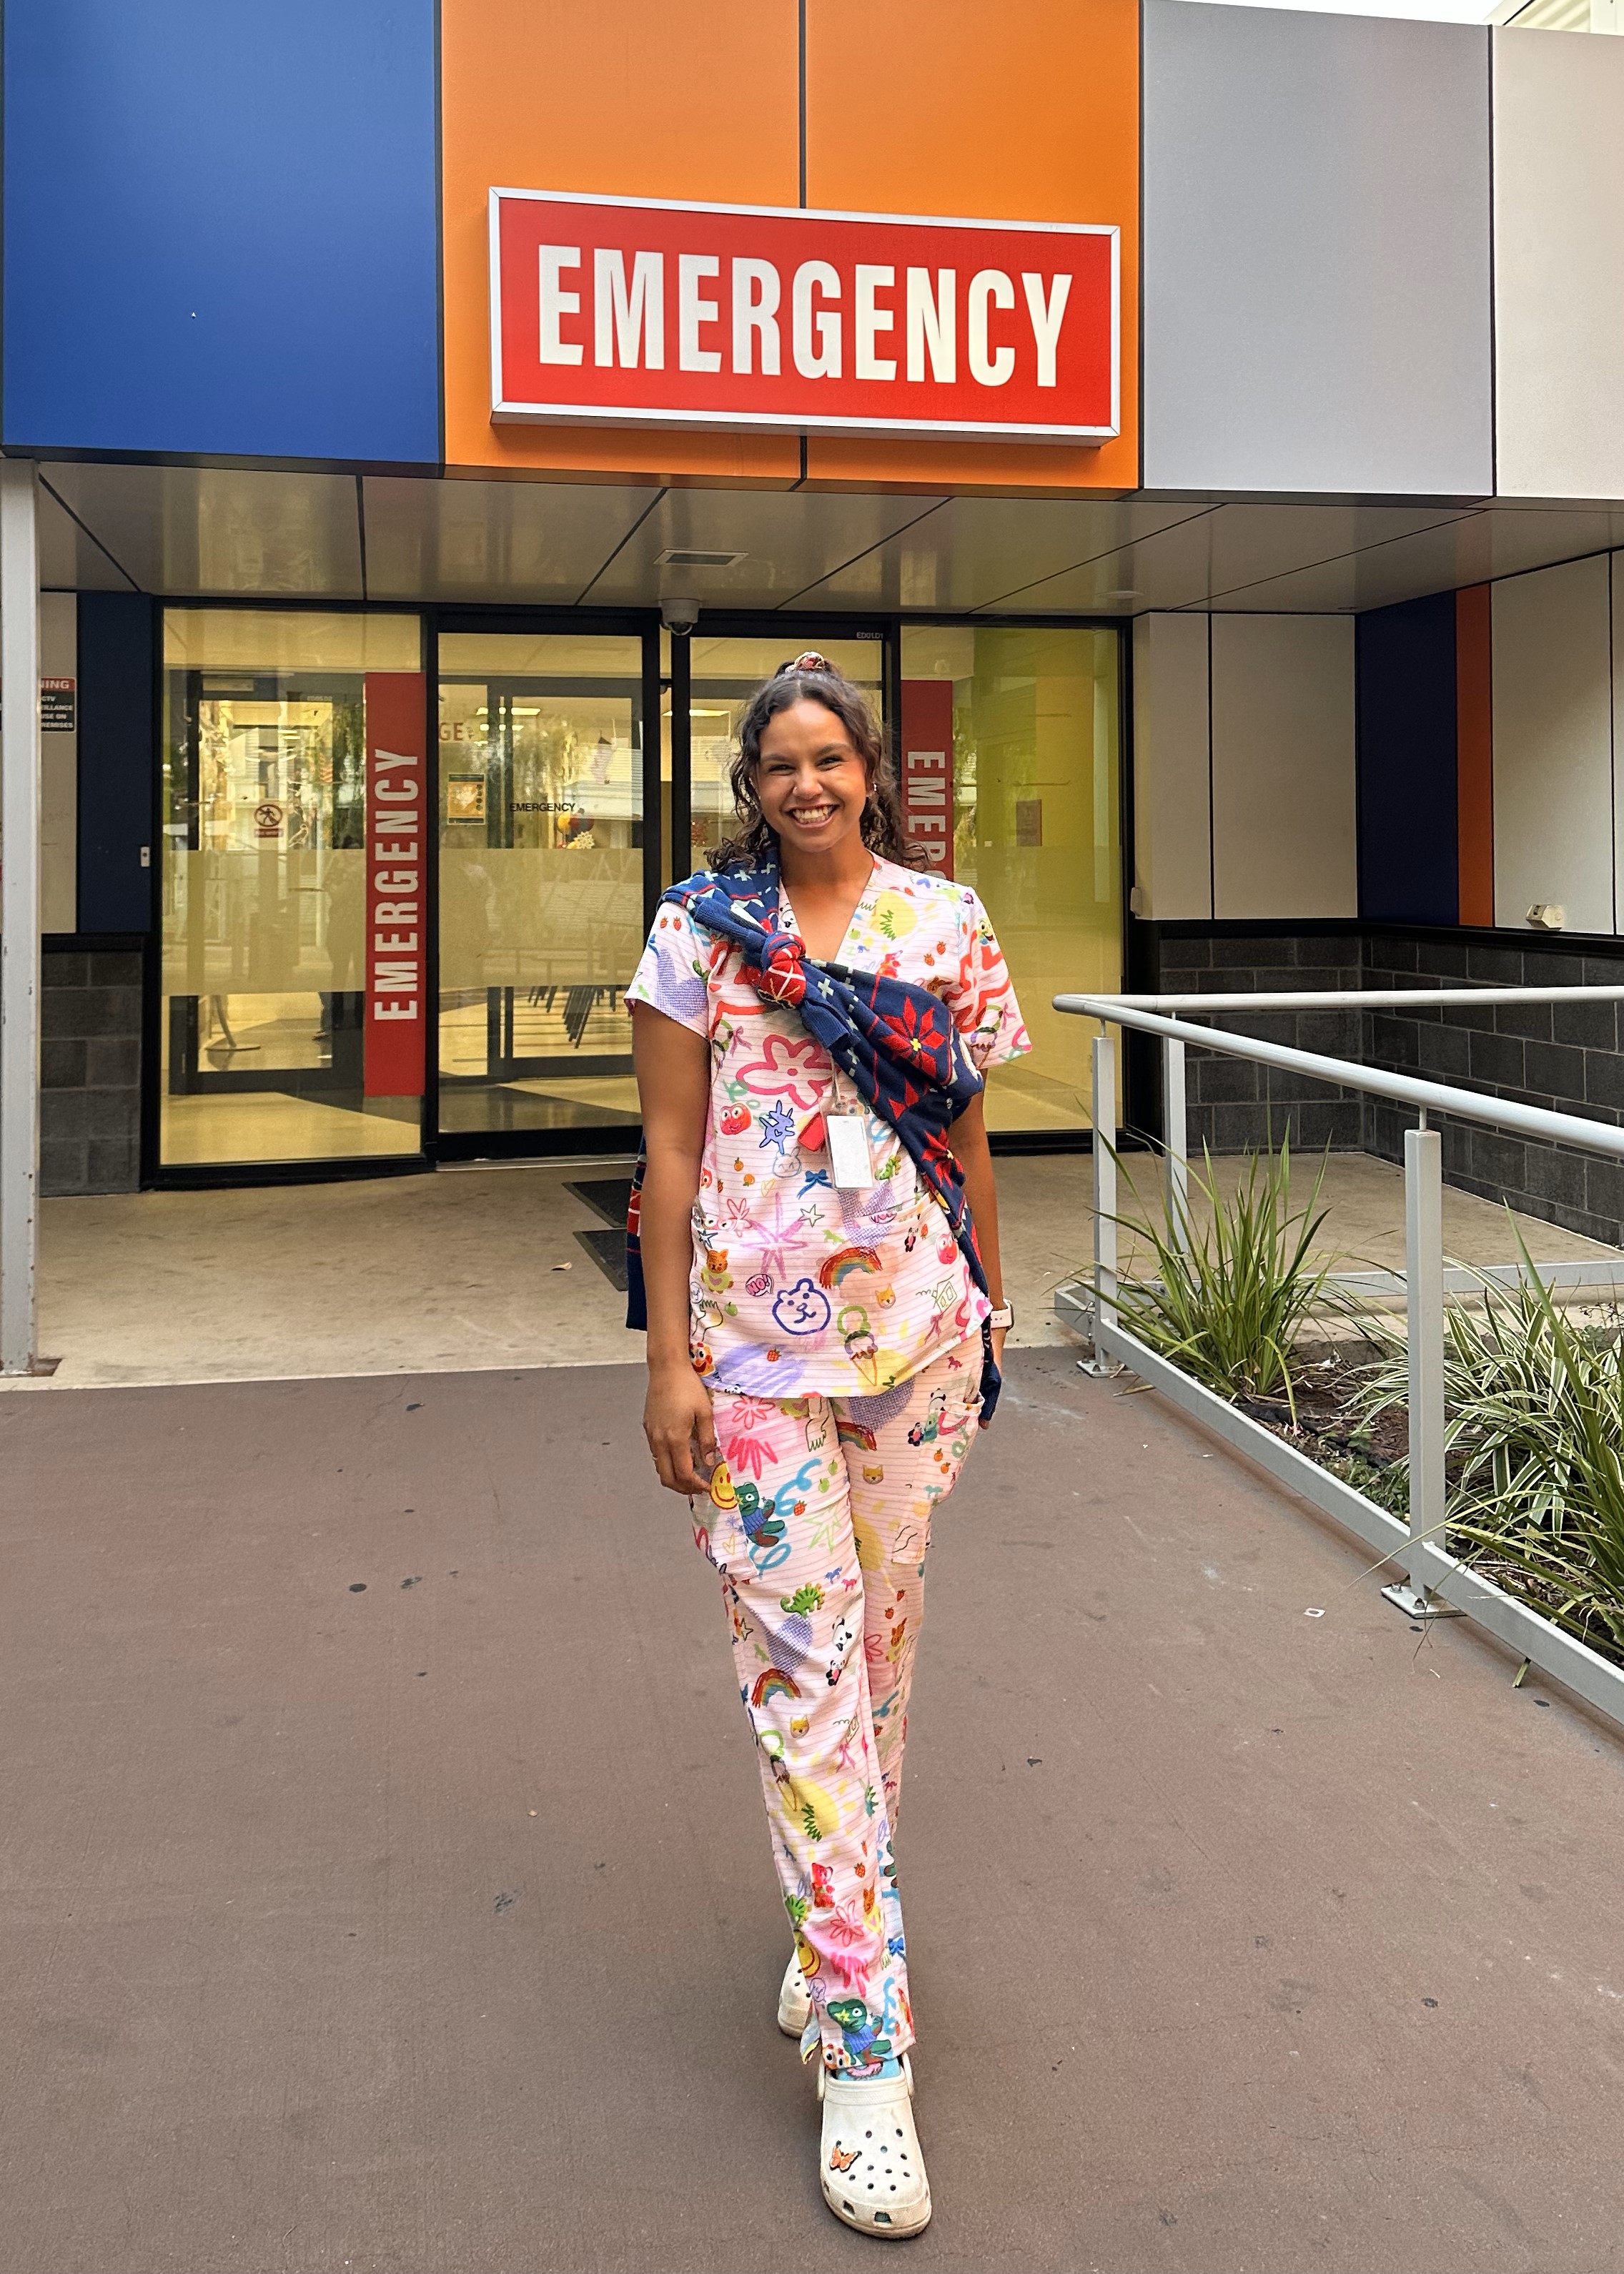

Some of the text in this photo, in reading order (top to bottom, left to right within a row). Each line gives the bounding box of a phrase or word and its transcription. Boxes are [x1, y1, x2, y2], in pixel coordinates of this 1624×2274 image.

[538, 244, 1073, 388] EMERGENCY
[510, 803, 575, 812] EMERGENCY
[907, 751, 947, 880] EMER
[374, 748, 418, 1021] EMERGENCY
